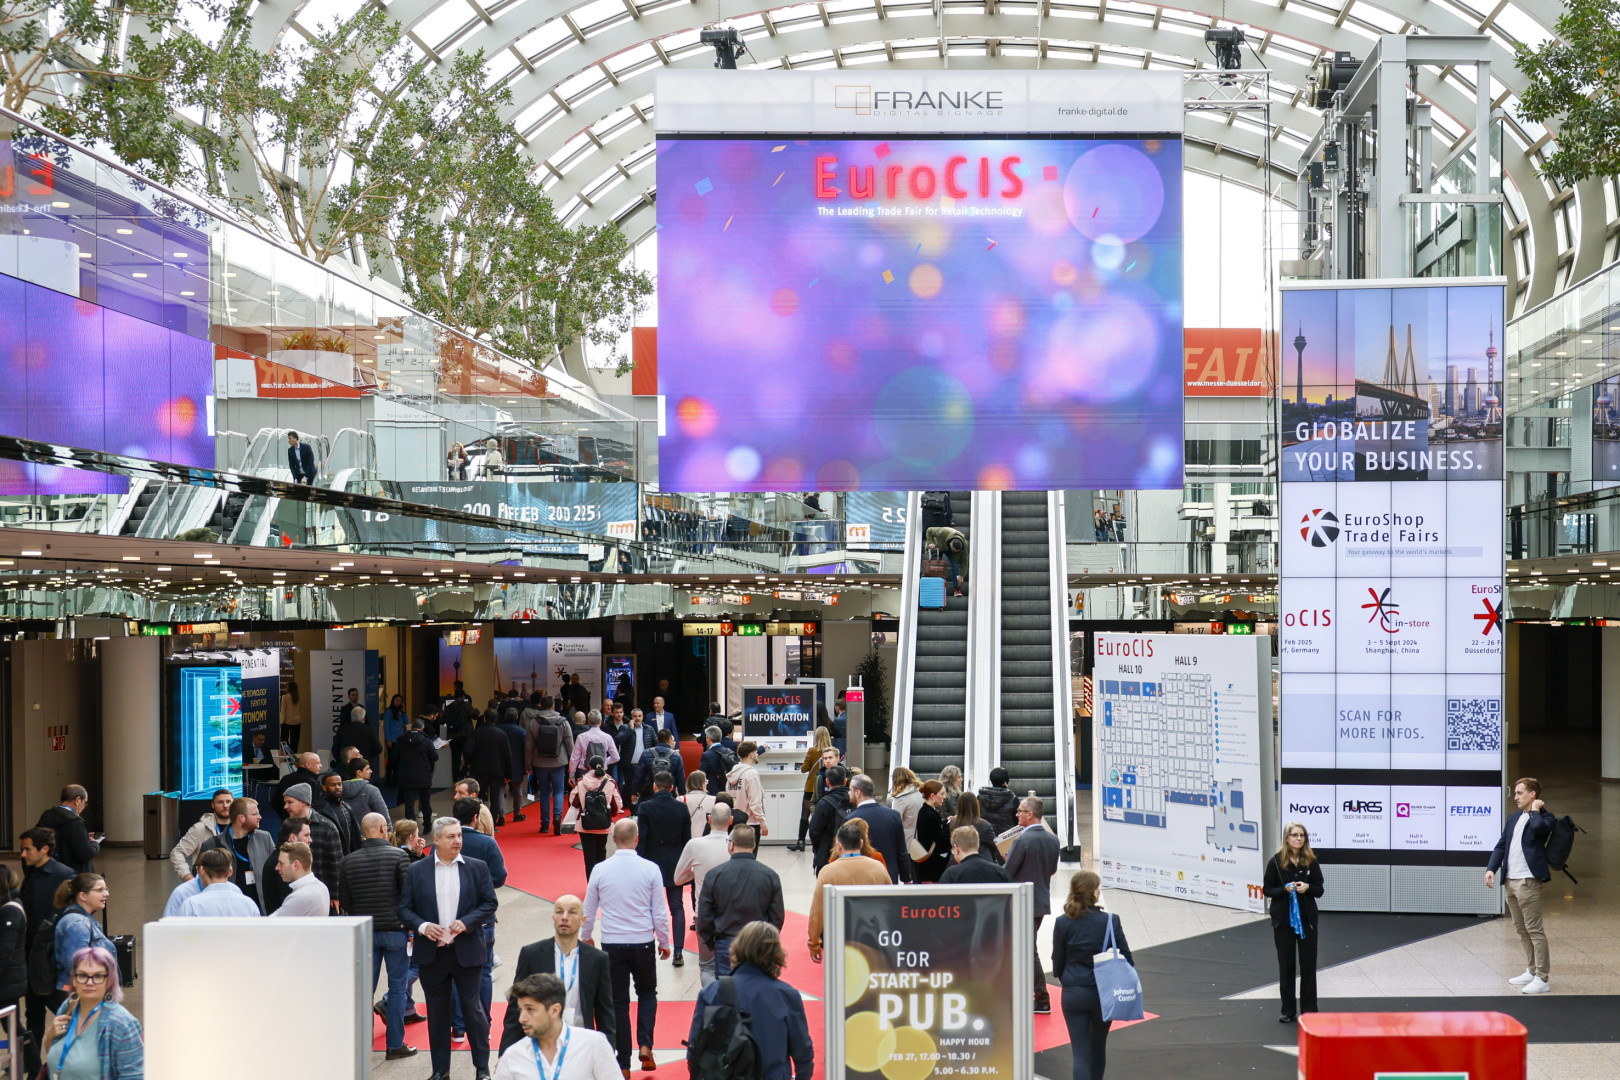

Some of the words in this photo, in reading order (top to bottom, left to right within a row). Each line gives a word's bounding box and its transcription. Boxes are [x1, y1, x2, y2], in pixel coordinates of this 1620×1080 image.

[874, 91, 1004, 109] FRANKE
[1058, 107, 1128, 117] franke-digital.de
[816, 155, 1025, 199] EuroCIS
[817, 207, 835, 216] The
[837, 207, 875, 218] Leading
[877, 207, 903, 216] Trade
[905, 207, 923, 216] Fair
[925, 207, 938, 216] for
[941, 207, 968, 216] Retail
[970, 207, 1023, 218] Technology
[1295, 421, 1416, 441] GLOBALIZE
[1295, 452, 1355, 471] YOUR
[1365, 450, 1483, 471] BUSINESS.
[1345, 513, 1424, 528] EuroShop
[1345, 530, 1390, 542] Trade
[1400, 529, 1439, 542] Fairs
[1395, 619, 1430, 627] in-store
[1098, 638, 1154, 657] EuroCIS
[1175, 656, 1191, 665] HALL
[1192, 656, 1198, 665] 9
[1118, 665, 1134, 674] HALL
[1134, 665, 1143, 674] 10
[757, 695, 801, 705] EuroCIS
[749, 713, 809, 722] INFORMATION
[1340, 710, 1371, 722] SCAN
[1377, 710, 1402, 722] FOR
[1340, 727, 1376, 739] MORE
[1381, 727, 1424, 739] INFOS.
[1289, 803, 1330, 815] Nayax
[1343, 800, 1382, 813] AURES
[1450, 806, 1492, 814] FEITIAN
[901, 906, 960, 918] EuroCIS
[878, 930, 902, 947] GO
[897, 951, 930, 967] FOR
[869, 972, 954, 989] START-UP
[879, 993, 984, 1031] PUB.
[939, 1038, 965, 1046] HAPPY
[968, 1038, 990, 1046] HOUR
[889, 1053, 903, 1061] FEB
[905, 1053, 917, 1062] 27,
[934, 1067, 953, 1075] 5.00
[960, 1066, 979, 1075] 6.30
[982, 1066, 999, 1075] P.M.
